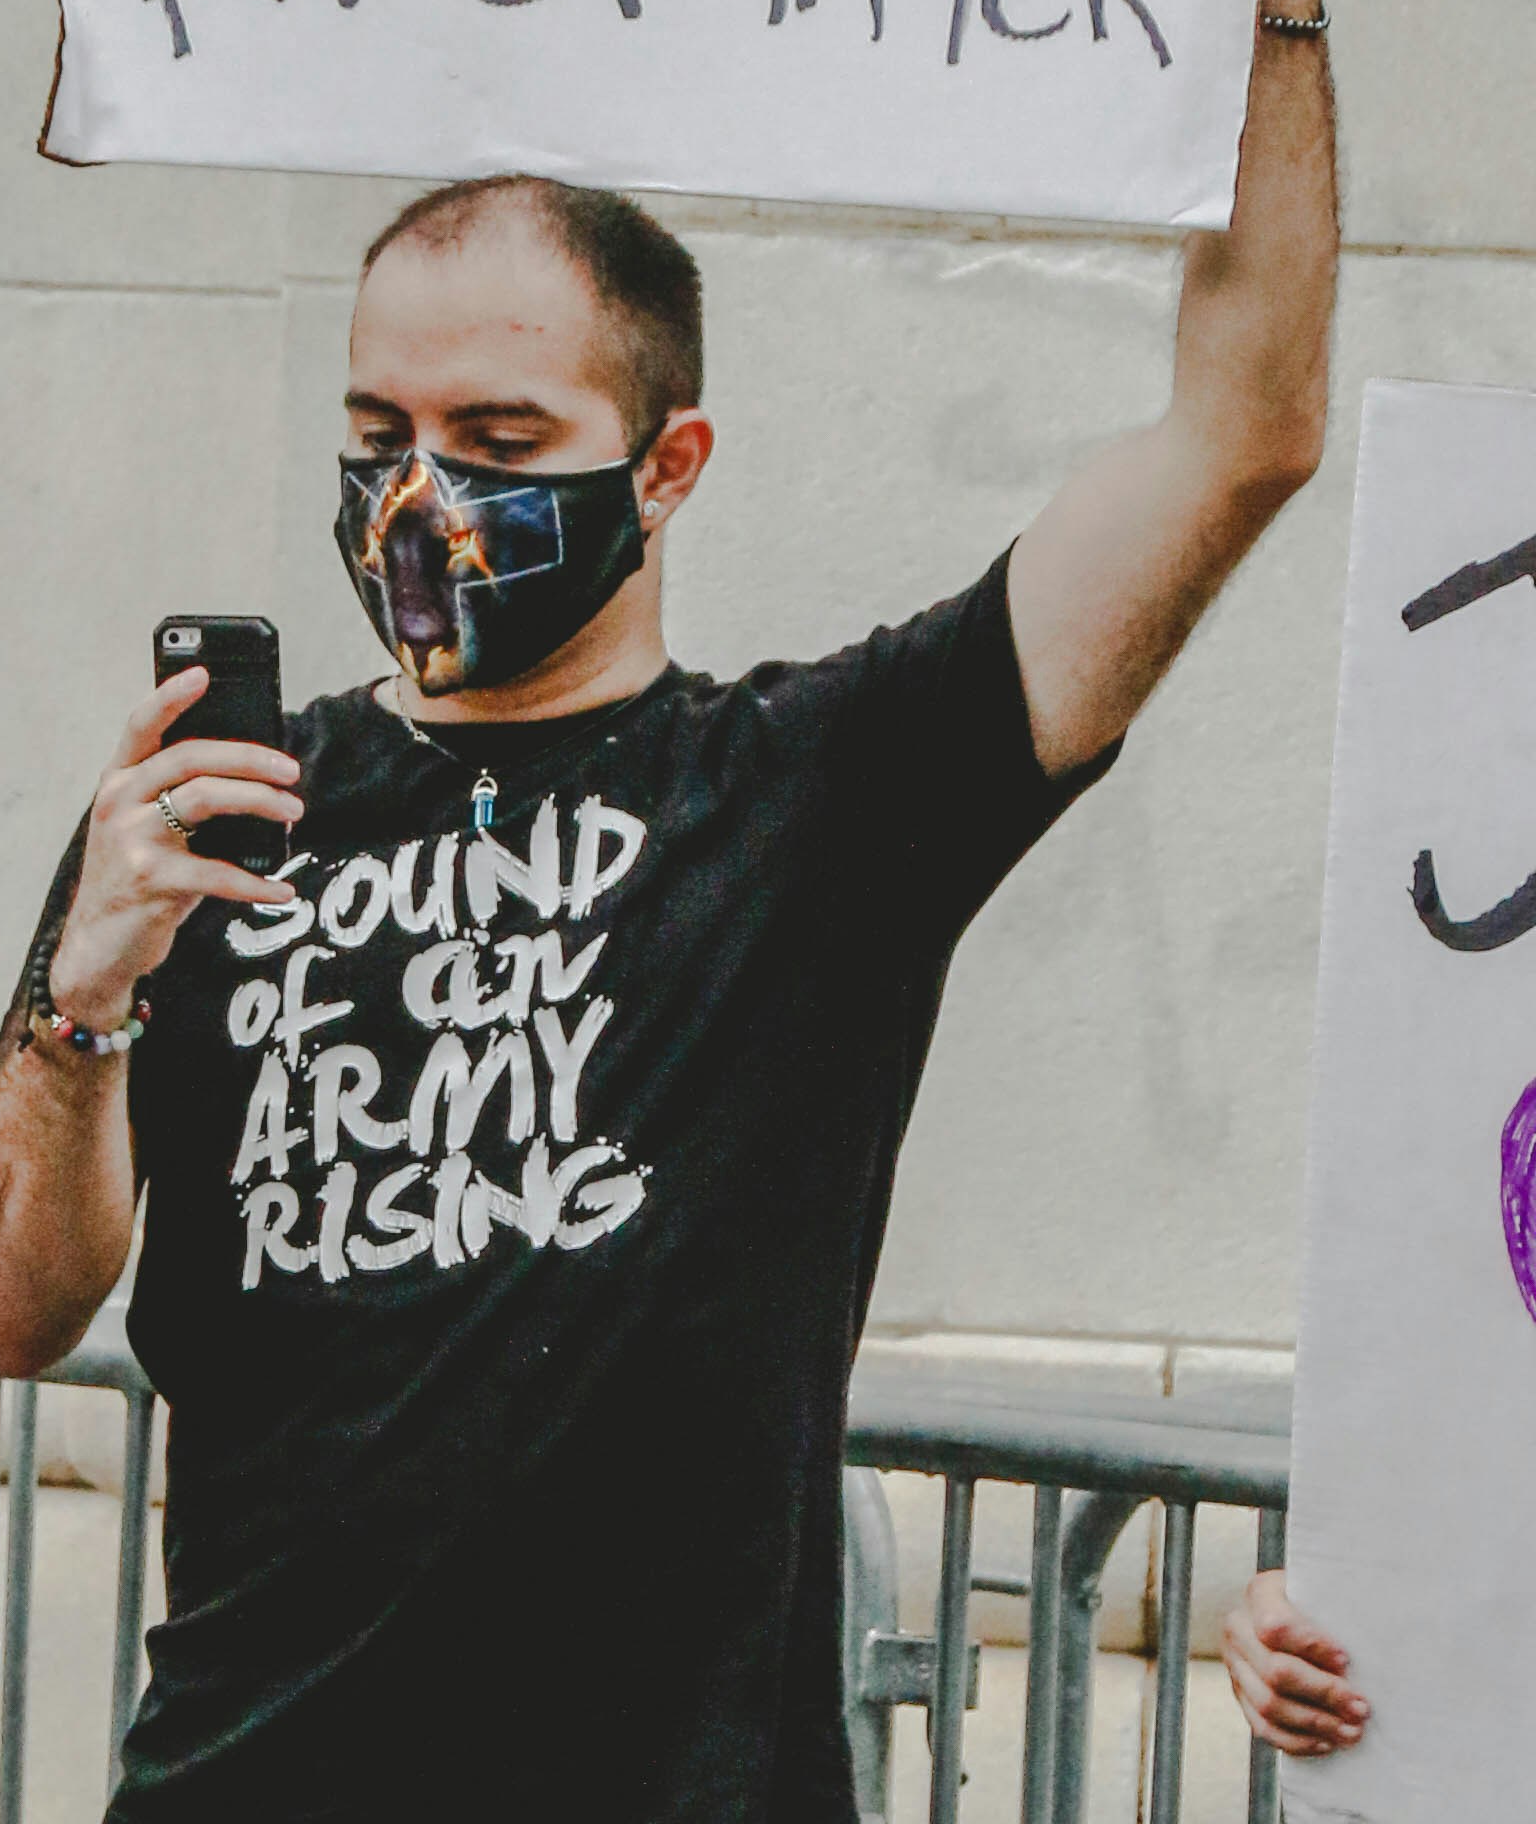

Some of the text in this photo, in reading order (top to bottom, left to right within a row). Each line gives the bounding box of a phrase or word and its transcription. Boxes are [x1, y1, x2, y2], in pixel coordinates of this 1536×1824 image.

[226, 792, 648, 957] SOUND
[229, 992, 615, 1183] ARMY
[238, 1131, 654, 1290] RISING
